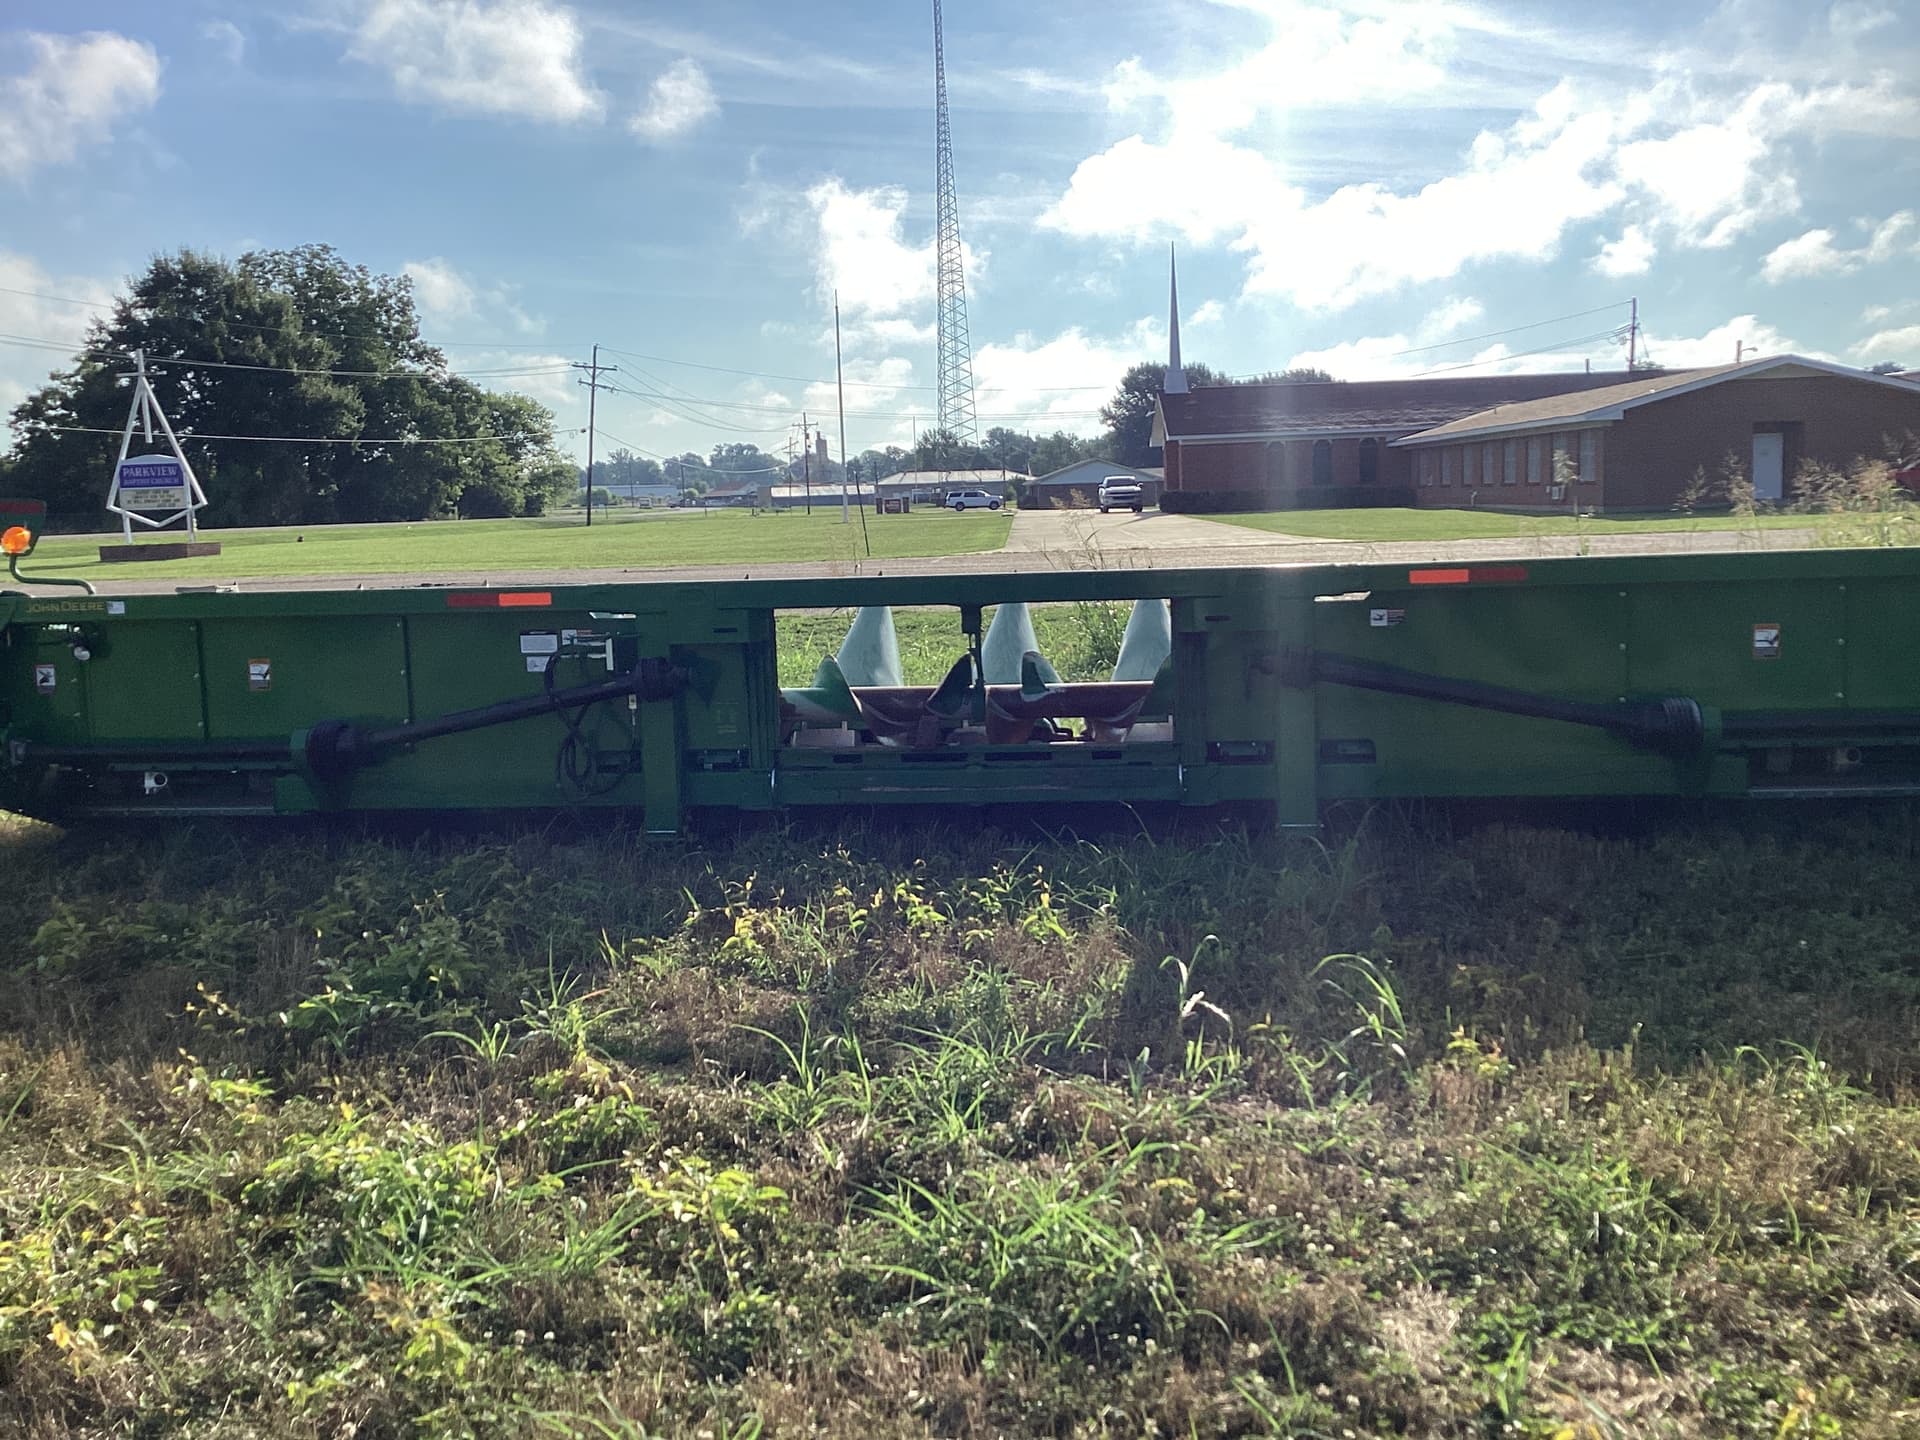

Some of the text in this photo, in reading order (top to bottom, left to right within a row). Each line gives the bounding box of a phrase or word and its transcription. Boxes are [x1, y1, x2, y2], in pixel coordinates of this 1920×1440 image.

[122, 466, 177, 477] PARKVIEW
[25, 601, 105, 613] JOHN DEERE
